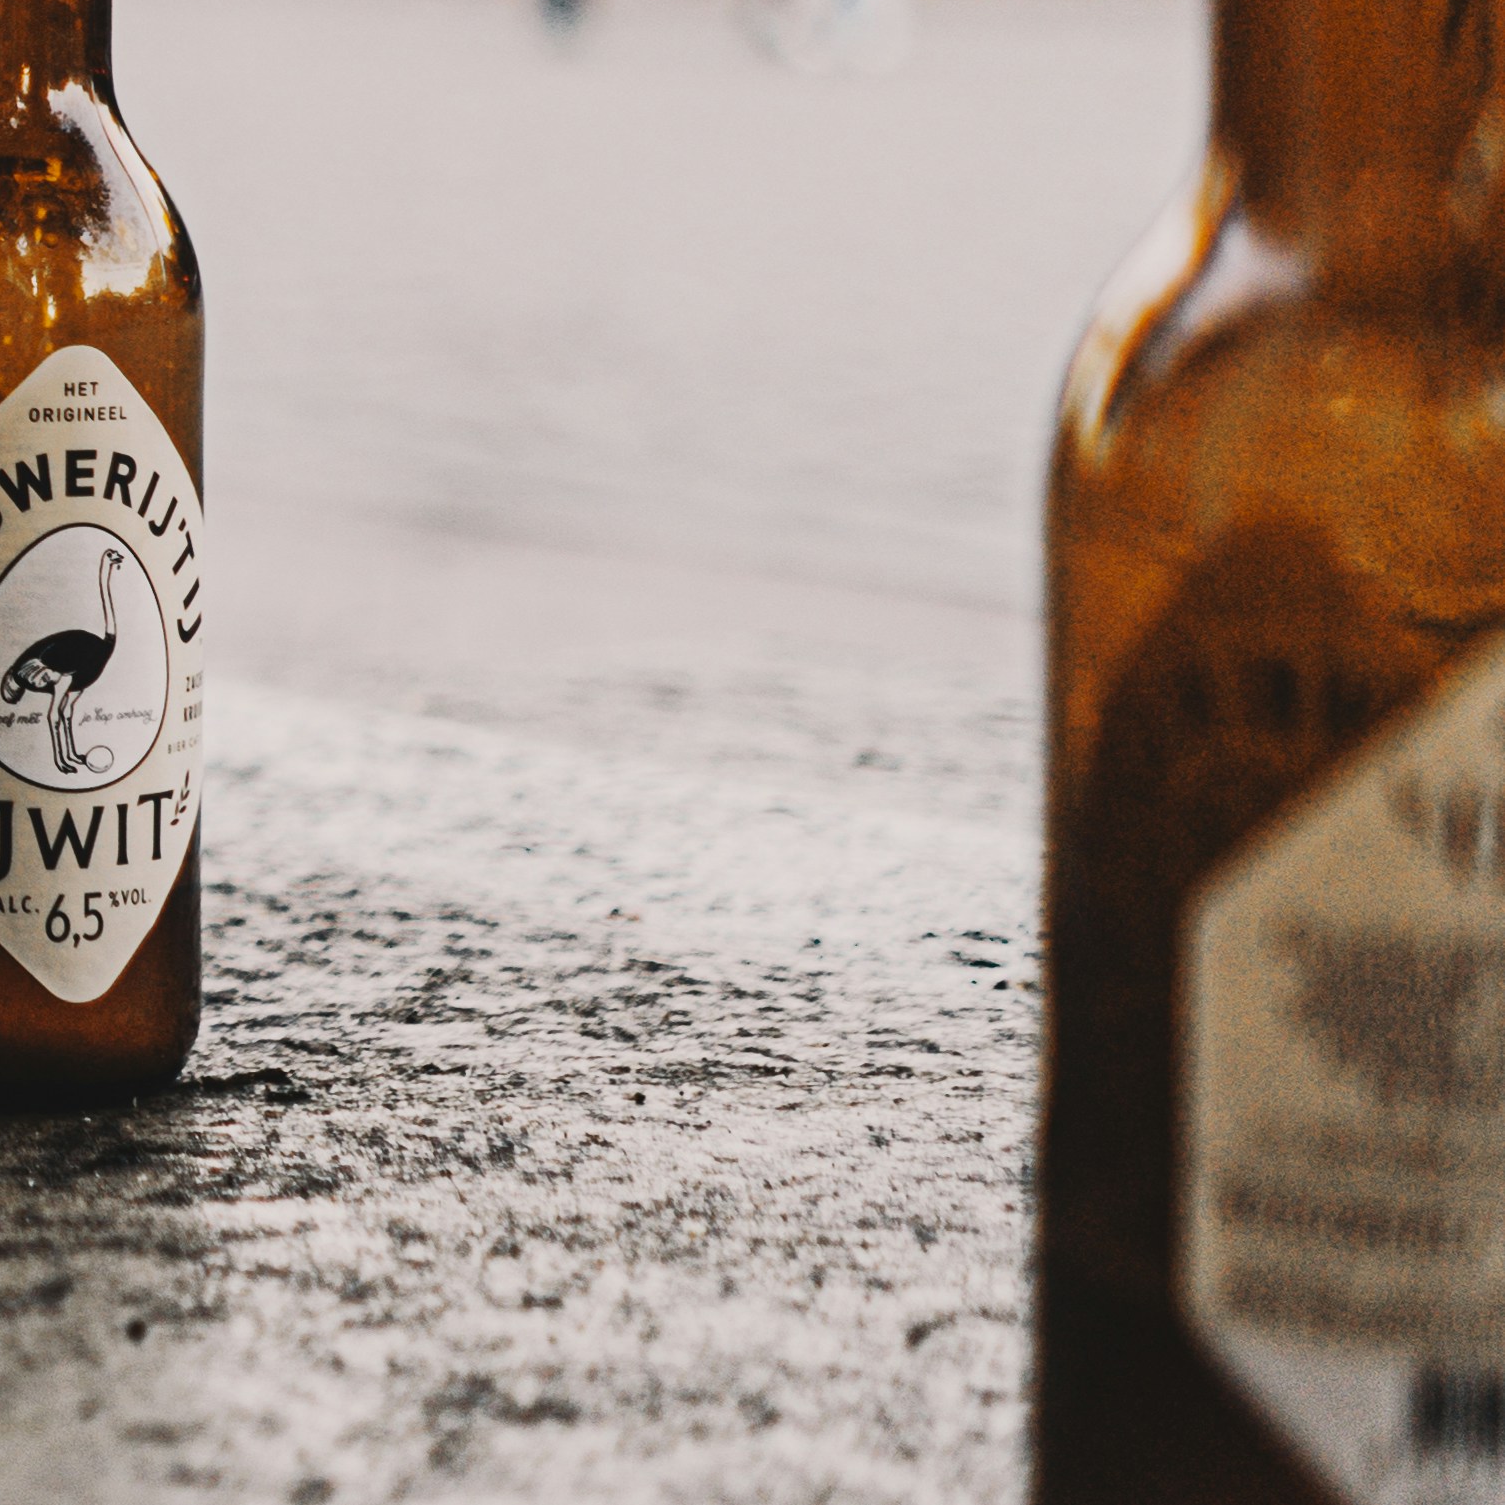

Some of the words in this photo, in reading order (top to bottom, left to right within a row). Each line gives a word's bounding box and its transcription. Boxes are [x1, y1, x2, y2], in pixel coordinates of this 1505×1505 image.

[64, 382, 99, 396] HET
[28, 406, 127, 423] ORIGINEEL
[45, 892, 104, 948] 6,5
